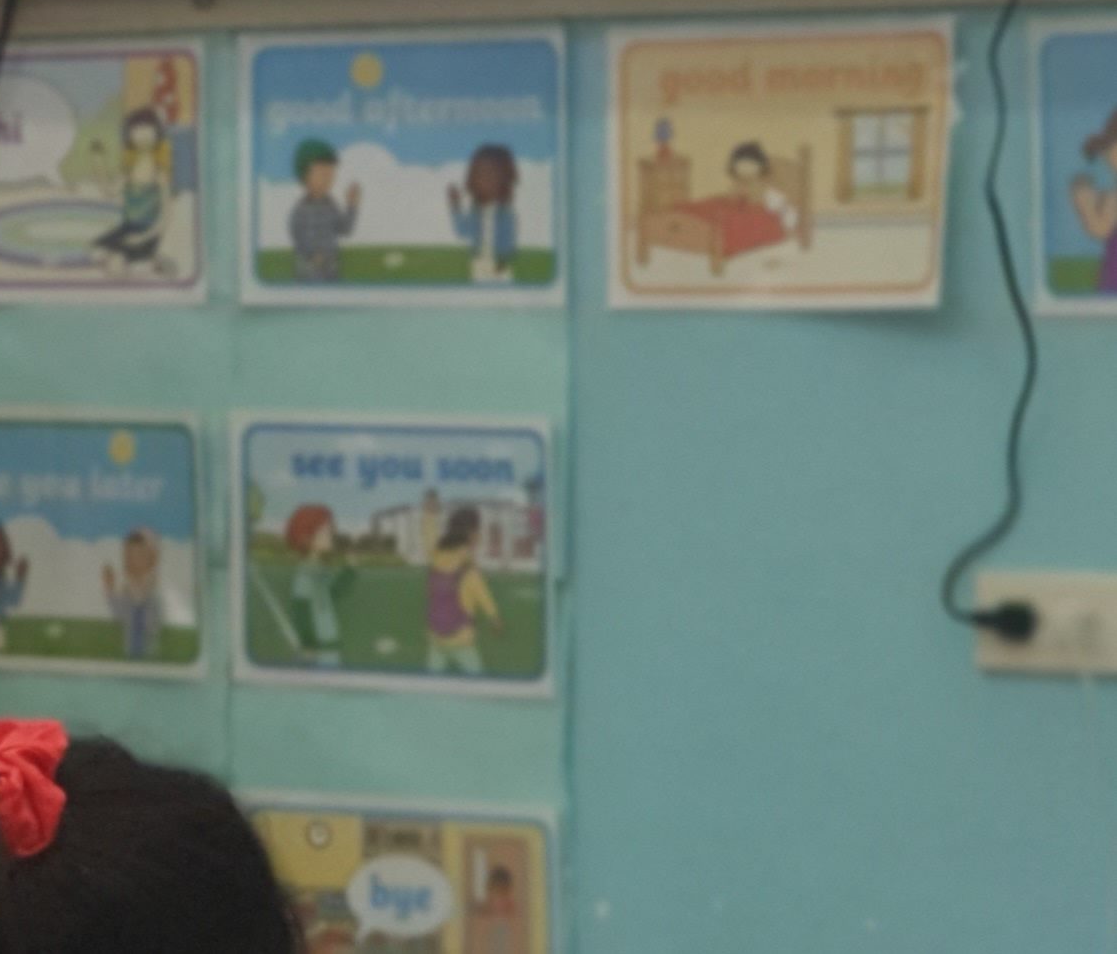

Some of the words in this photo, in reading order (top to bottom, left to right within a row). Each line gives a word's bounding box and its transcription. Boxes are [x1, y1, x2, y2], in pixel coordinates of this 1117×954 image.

[658, 60, 752, 106] good
[766, 57, 925, 100] morning
[266, 91, 351, 135] good
[364, 88, 541, 133] afternoon
[290, 453, 344, 479] see
[357, 454, 423, 490] you
[436, 457, 516, 483] soon
[369, 869, 432, 921] bye
